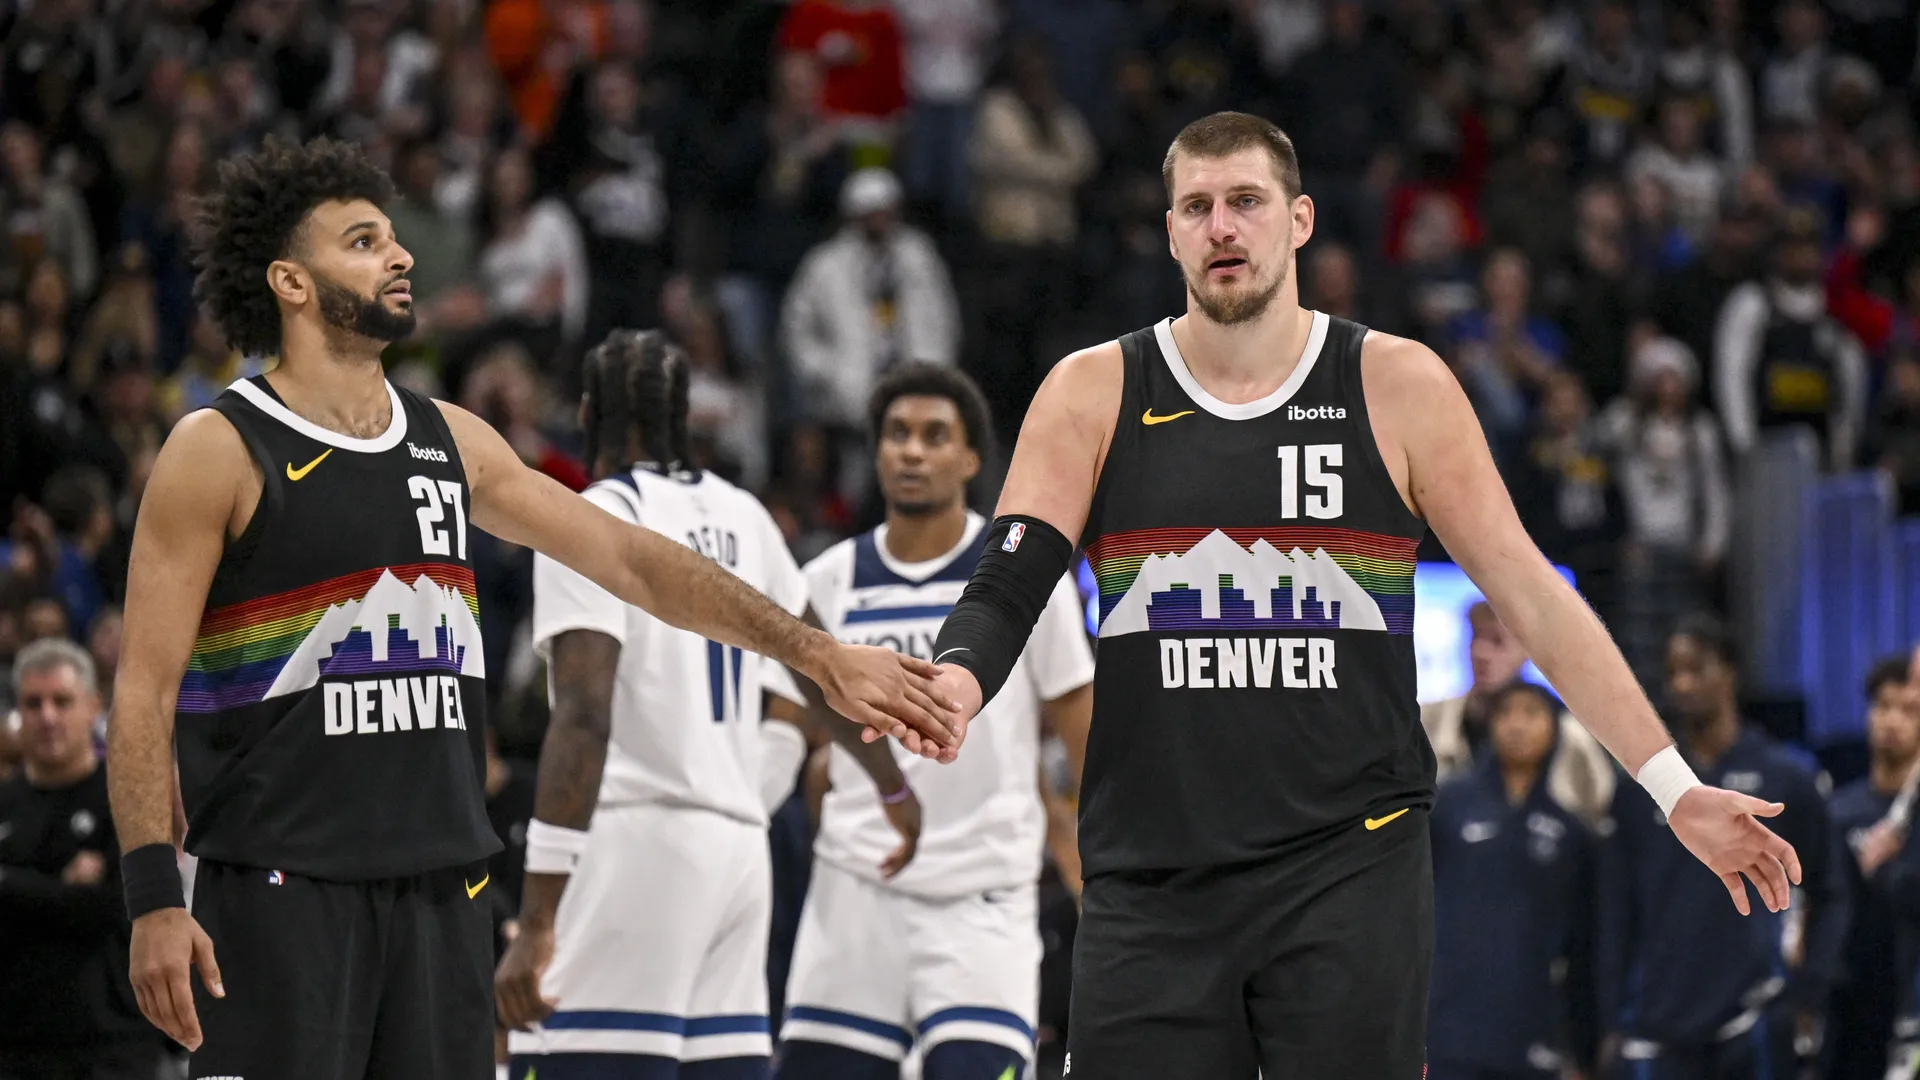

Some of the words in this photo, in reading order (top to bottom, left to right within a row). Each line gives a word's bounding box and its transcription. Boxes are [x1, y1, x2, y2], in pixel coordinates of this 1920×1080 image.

[1287, 405, 1347, 420] ibotta
[407, 442, 449, 462] ibotta
[1277, 443, 1343, 520] 15
[407, 475, 467, 561] 27
[1159, 637, 1339, 689] DENVER
